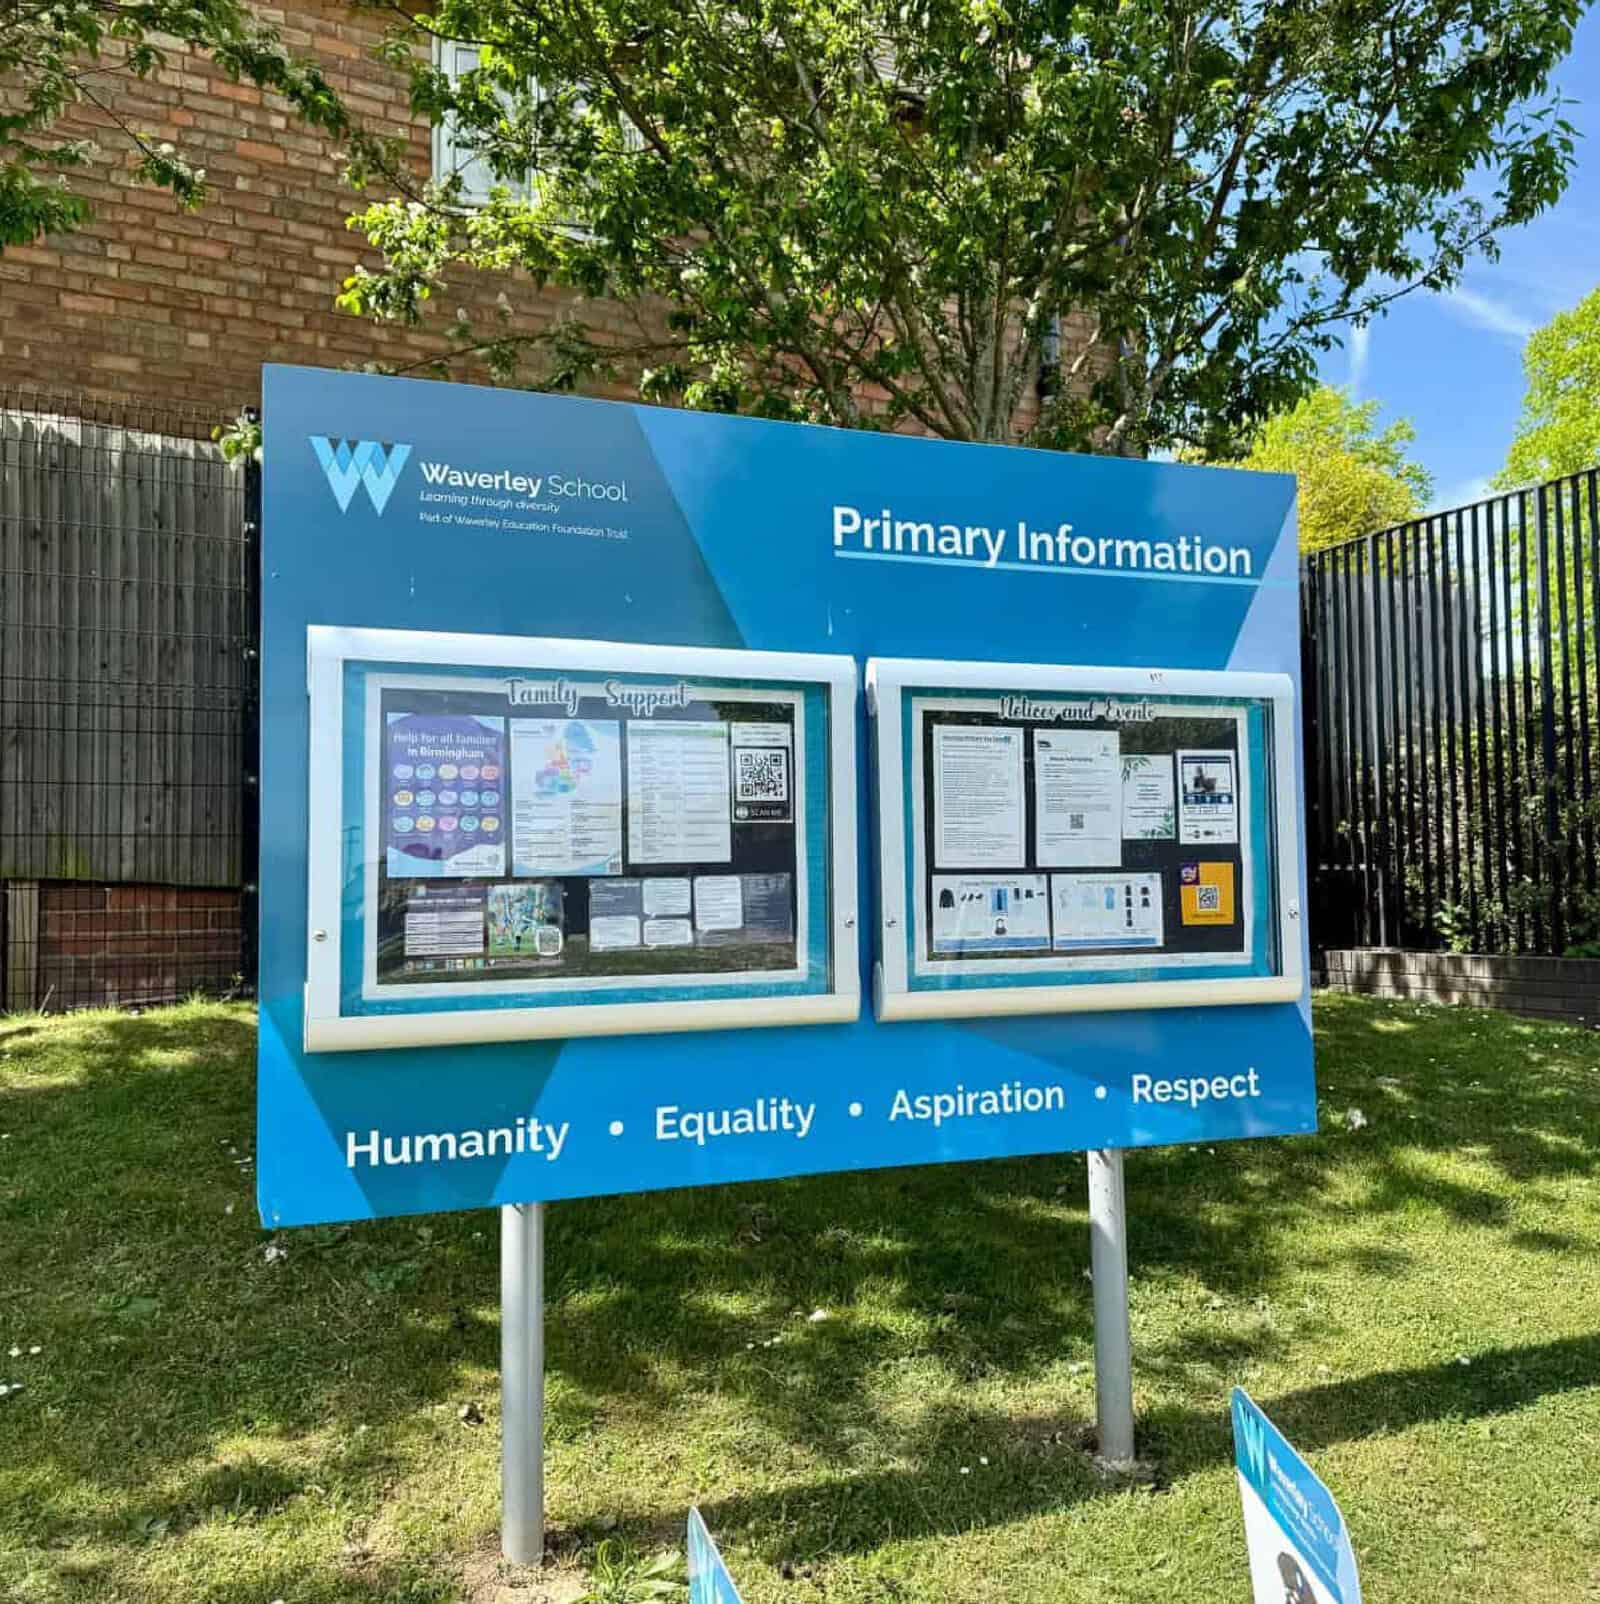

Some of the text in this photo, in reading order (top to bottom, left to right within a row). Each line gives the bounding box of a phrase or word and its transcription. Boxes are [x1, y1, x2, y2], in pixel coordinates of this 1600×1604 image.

[420, 462, 629, 502] Waverley School
[420, 490, 561, 514] Learning through diversity
[419, 512, 628, 539] Part of Waverley Education Foundation Trust
[832, 506, 1252, 576] Primary Information
[504, 677, 690, 717] Family Support
[999, 695, 1155, 723] Notices and Events
[393, 731, 497, 746] Help for all families
[408, 746, 485, 761] in Birmingham
[346, 1067, 1261, 1168] Humanity Equality Aspiration Respect
